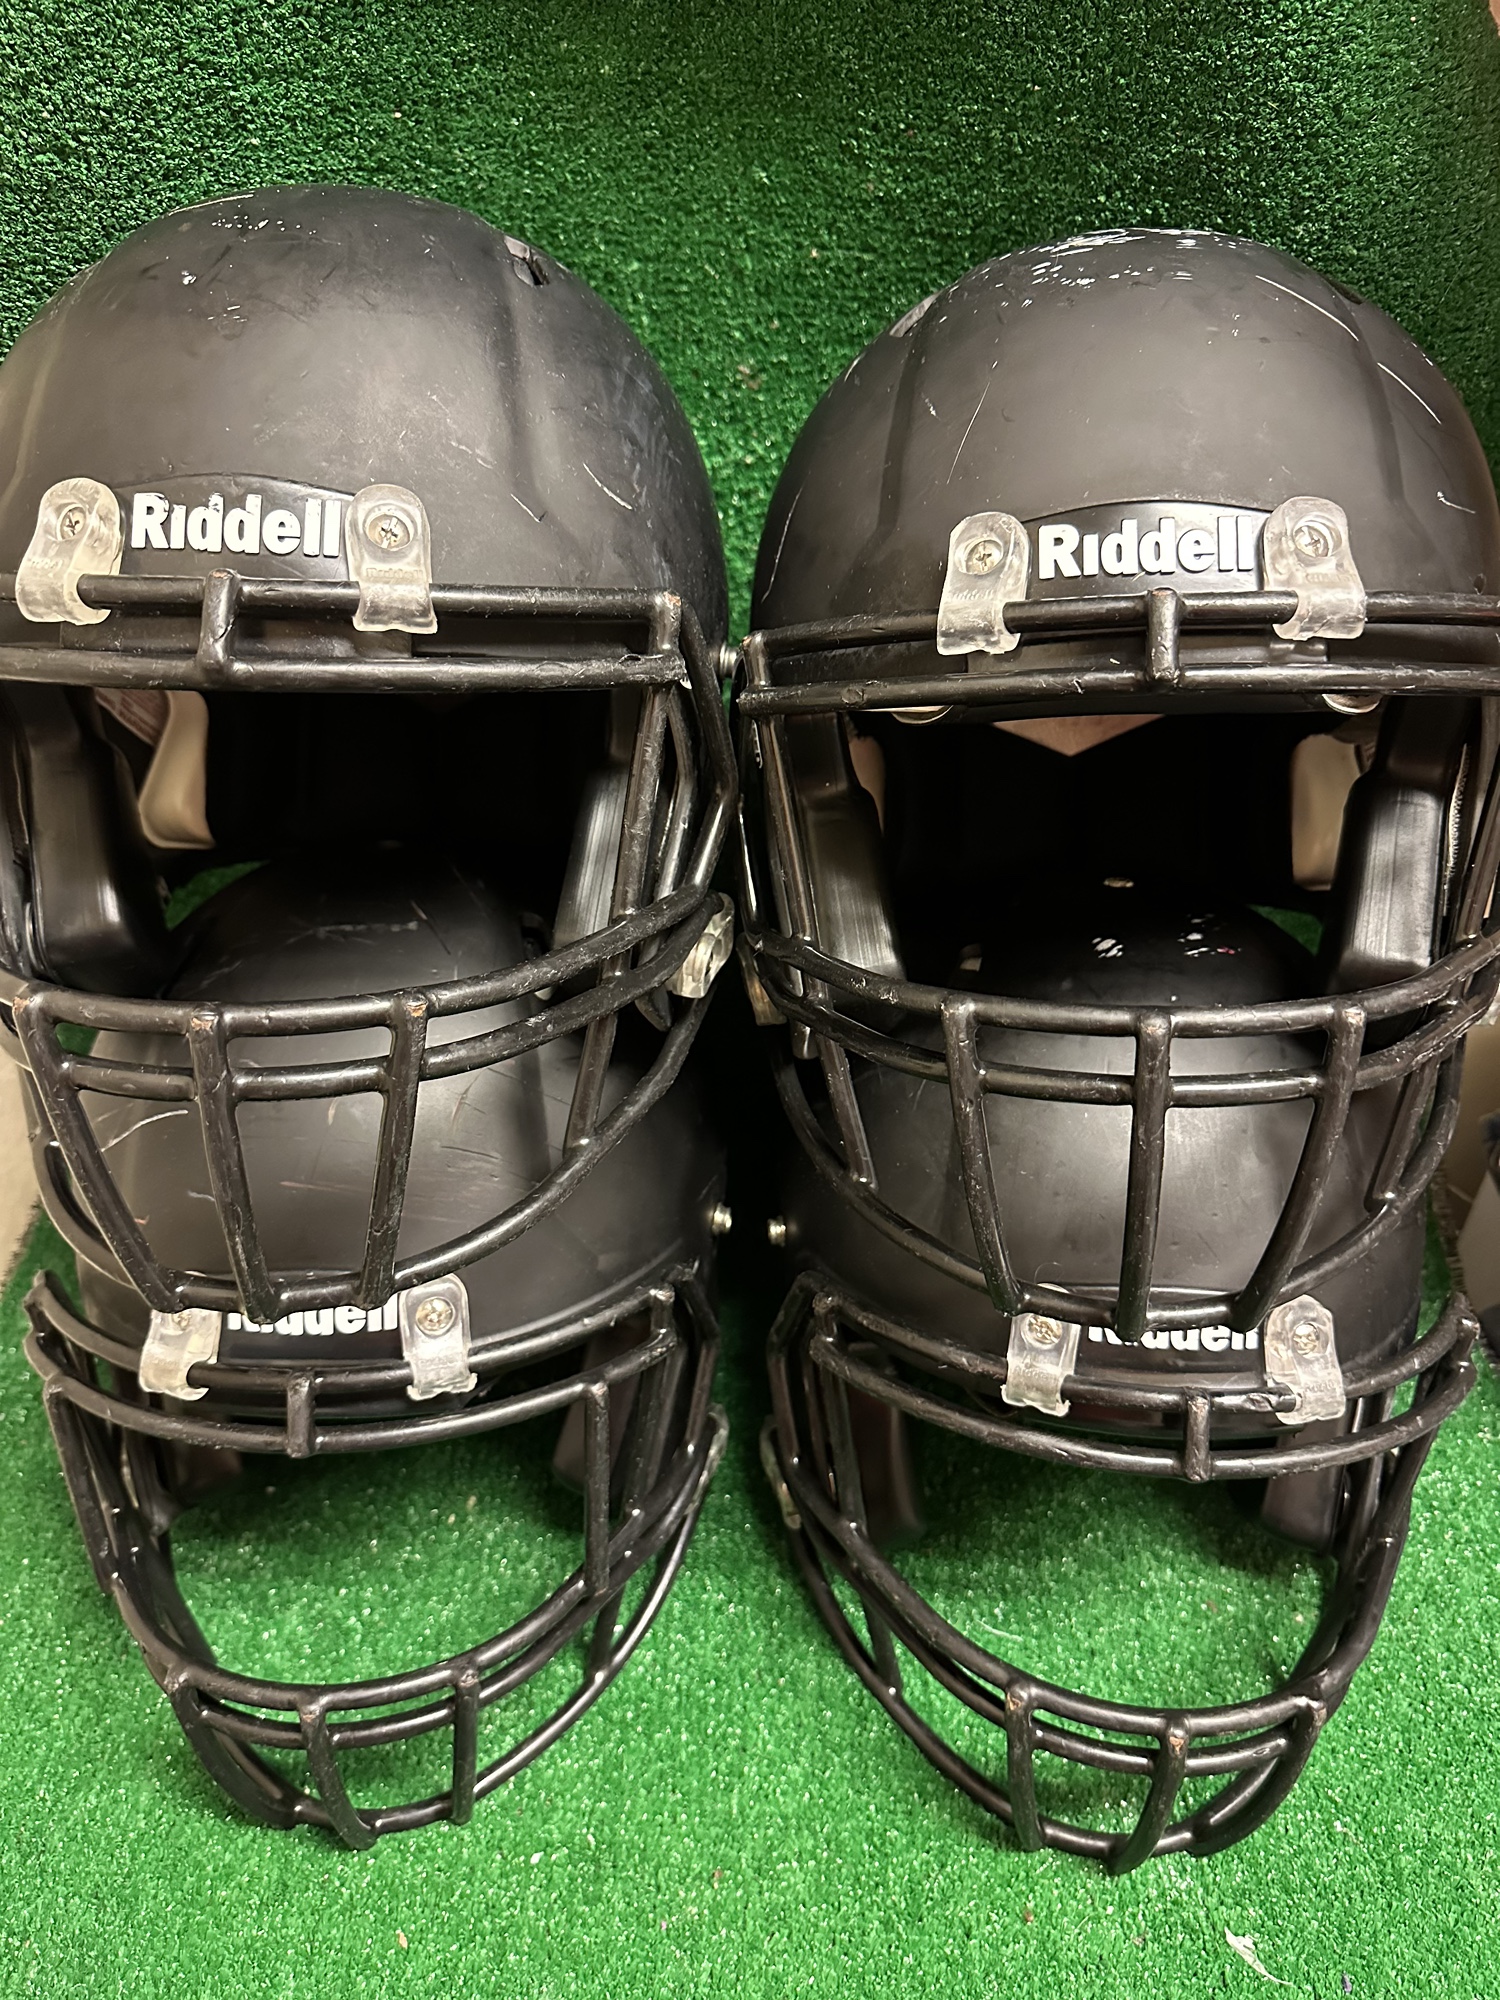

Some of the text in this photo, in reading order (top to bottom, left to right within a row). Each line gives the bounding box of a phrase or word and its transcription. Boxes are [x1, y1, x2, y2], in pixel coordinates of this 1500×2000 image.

[131, 492, 342, 558] Riddell
[1038, 515, 1254, 579] Riddell
[227, 1292, 399, 1336] ddell
